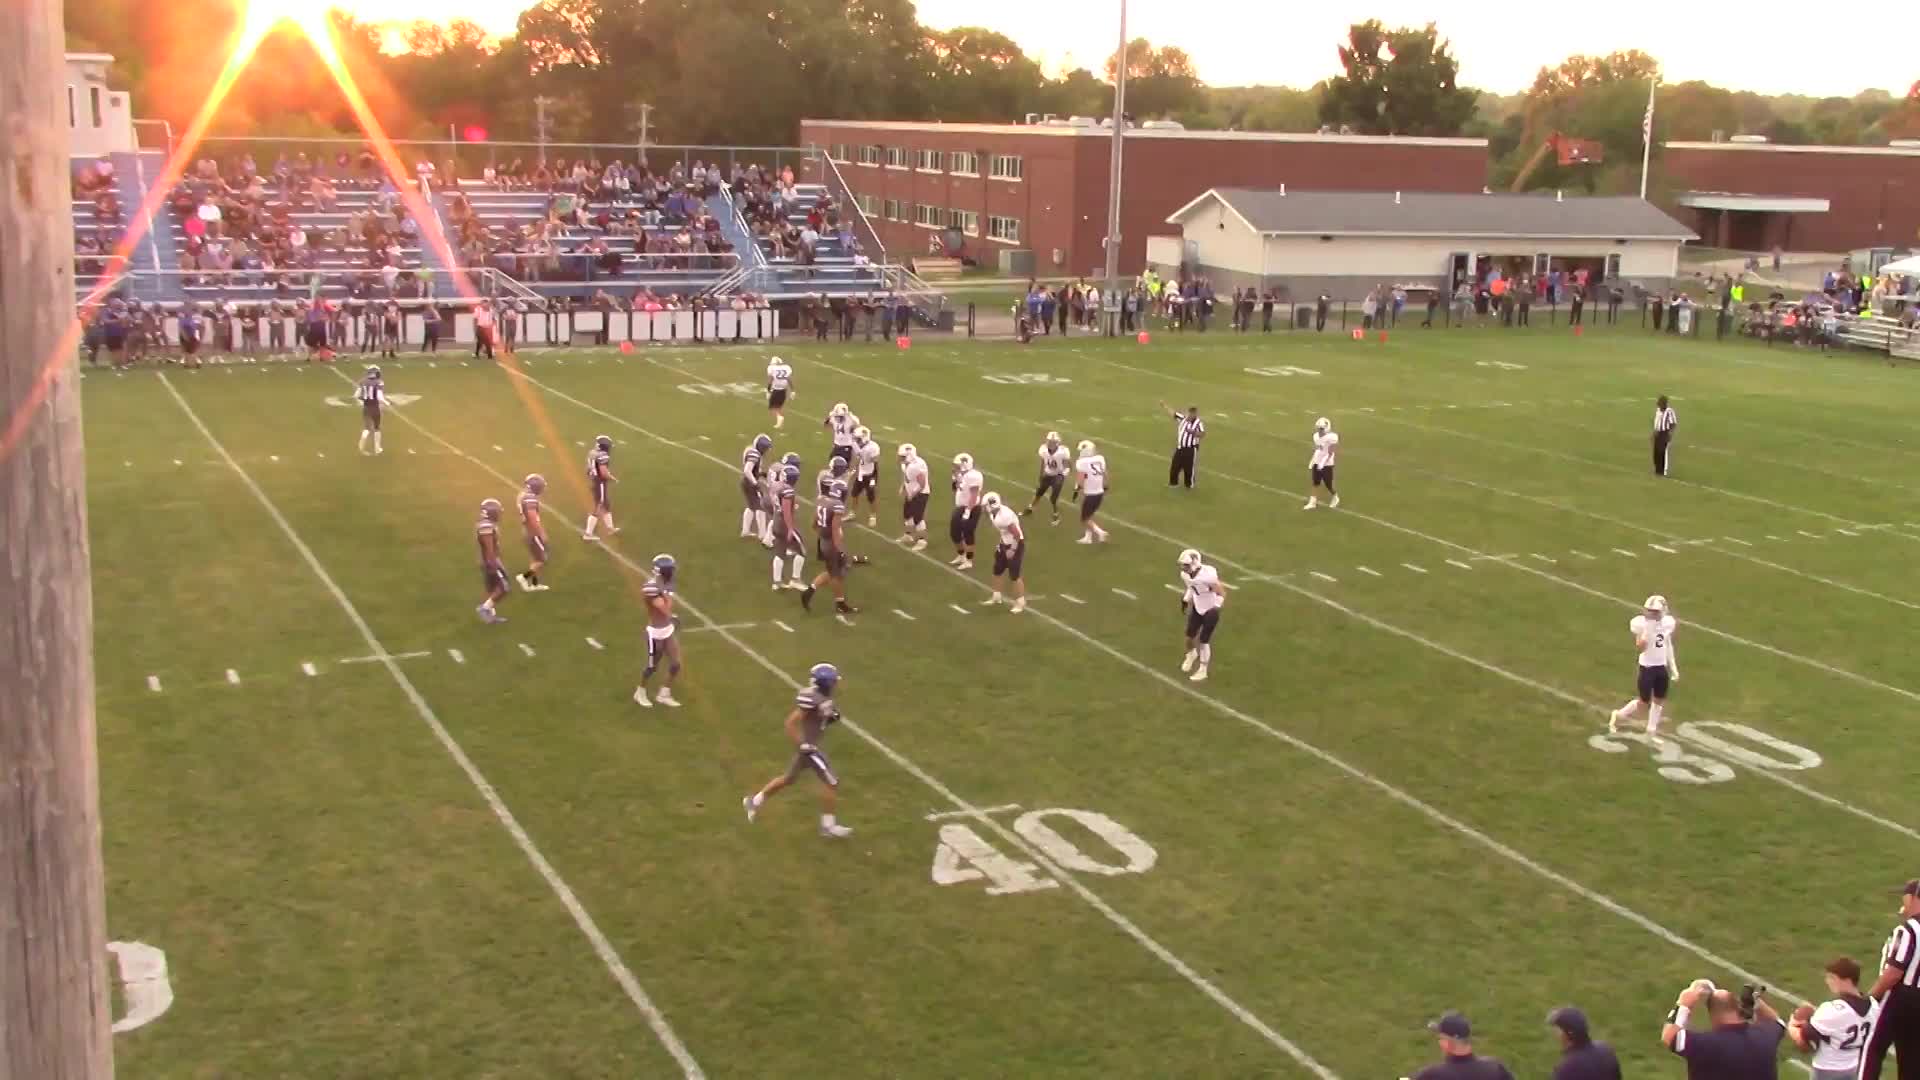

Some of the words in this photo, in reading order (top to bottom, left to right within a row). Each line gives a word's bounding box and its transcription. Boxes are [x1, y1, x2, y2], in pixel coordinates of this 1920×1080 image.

[776, 369, 788, 380] 22
[1655, 633, 1665, 649] 2
[1590, 720, 1822, 784] 30
[931, 807, 1158, 896] 40
